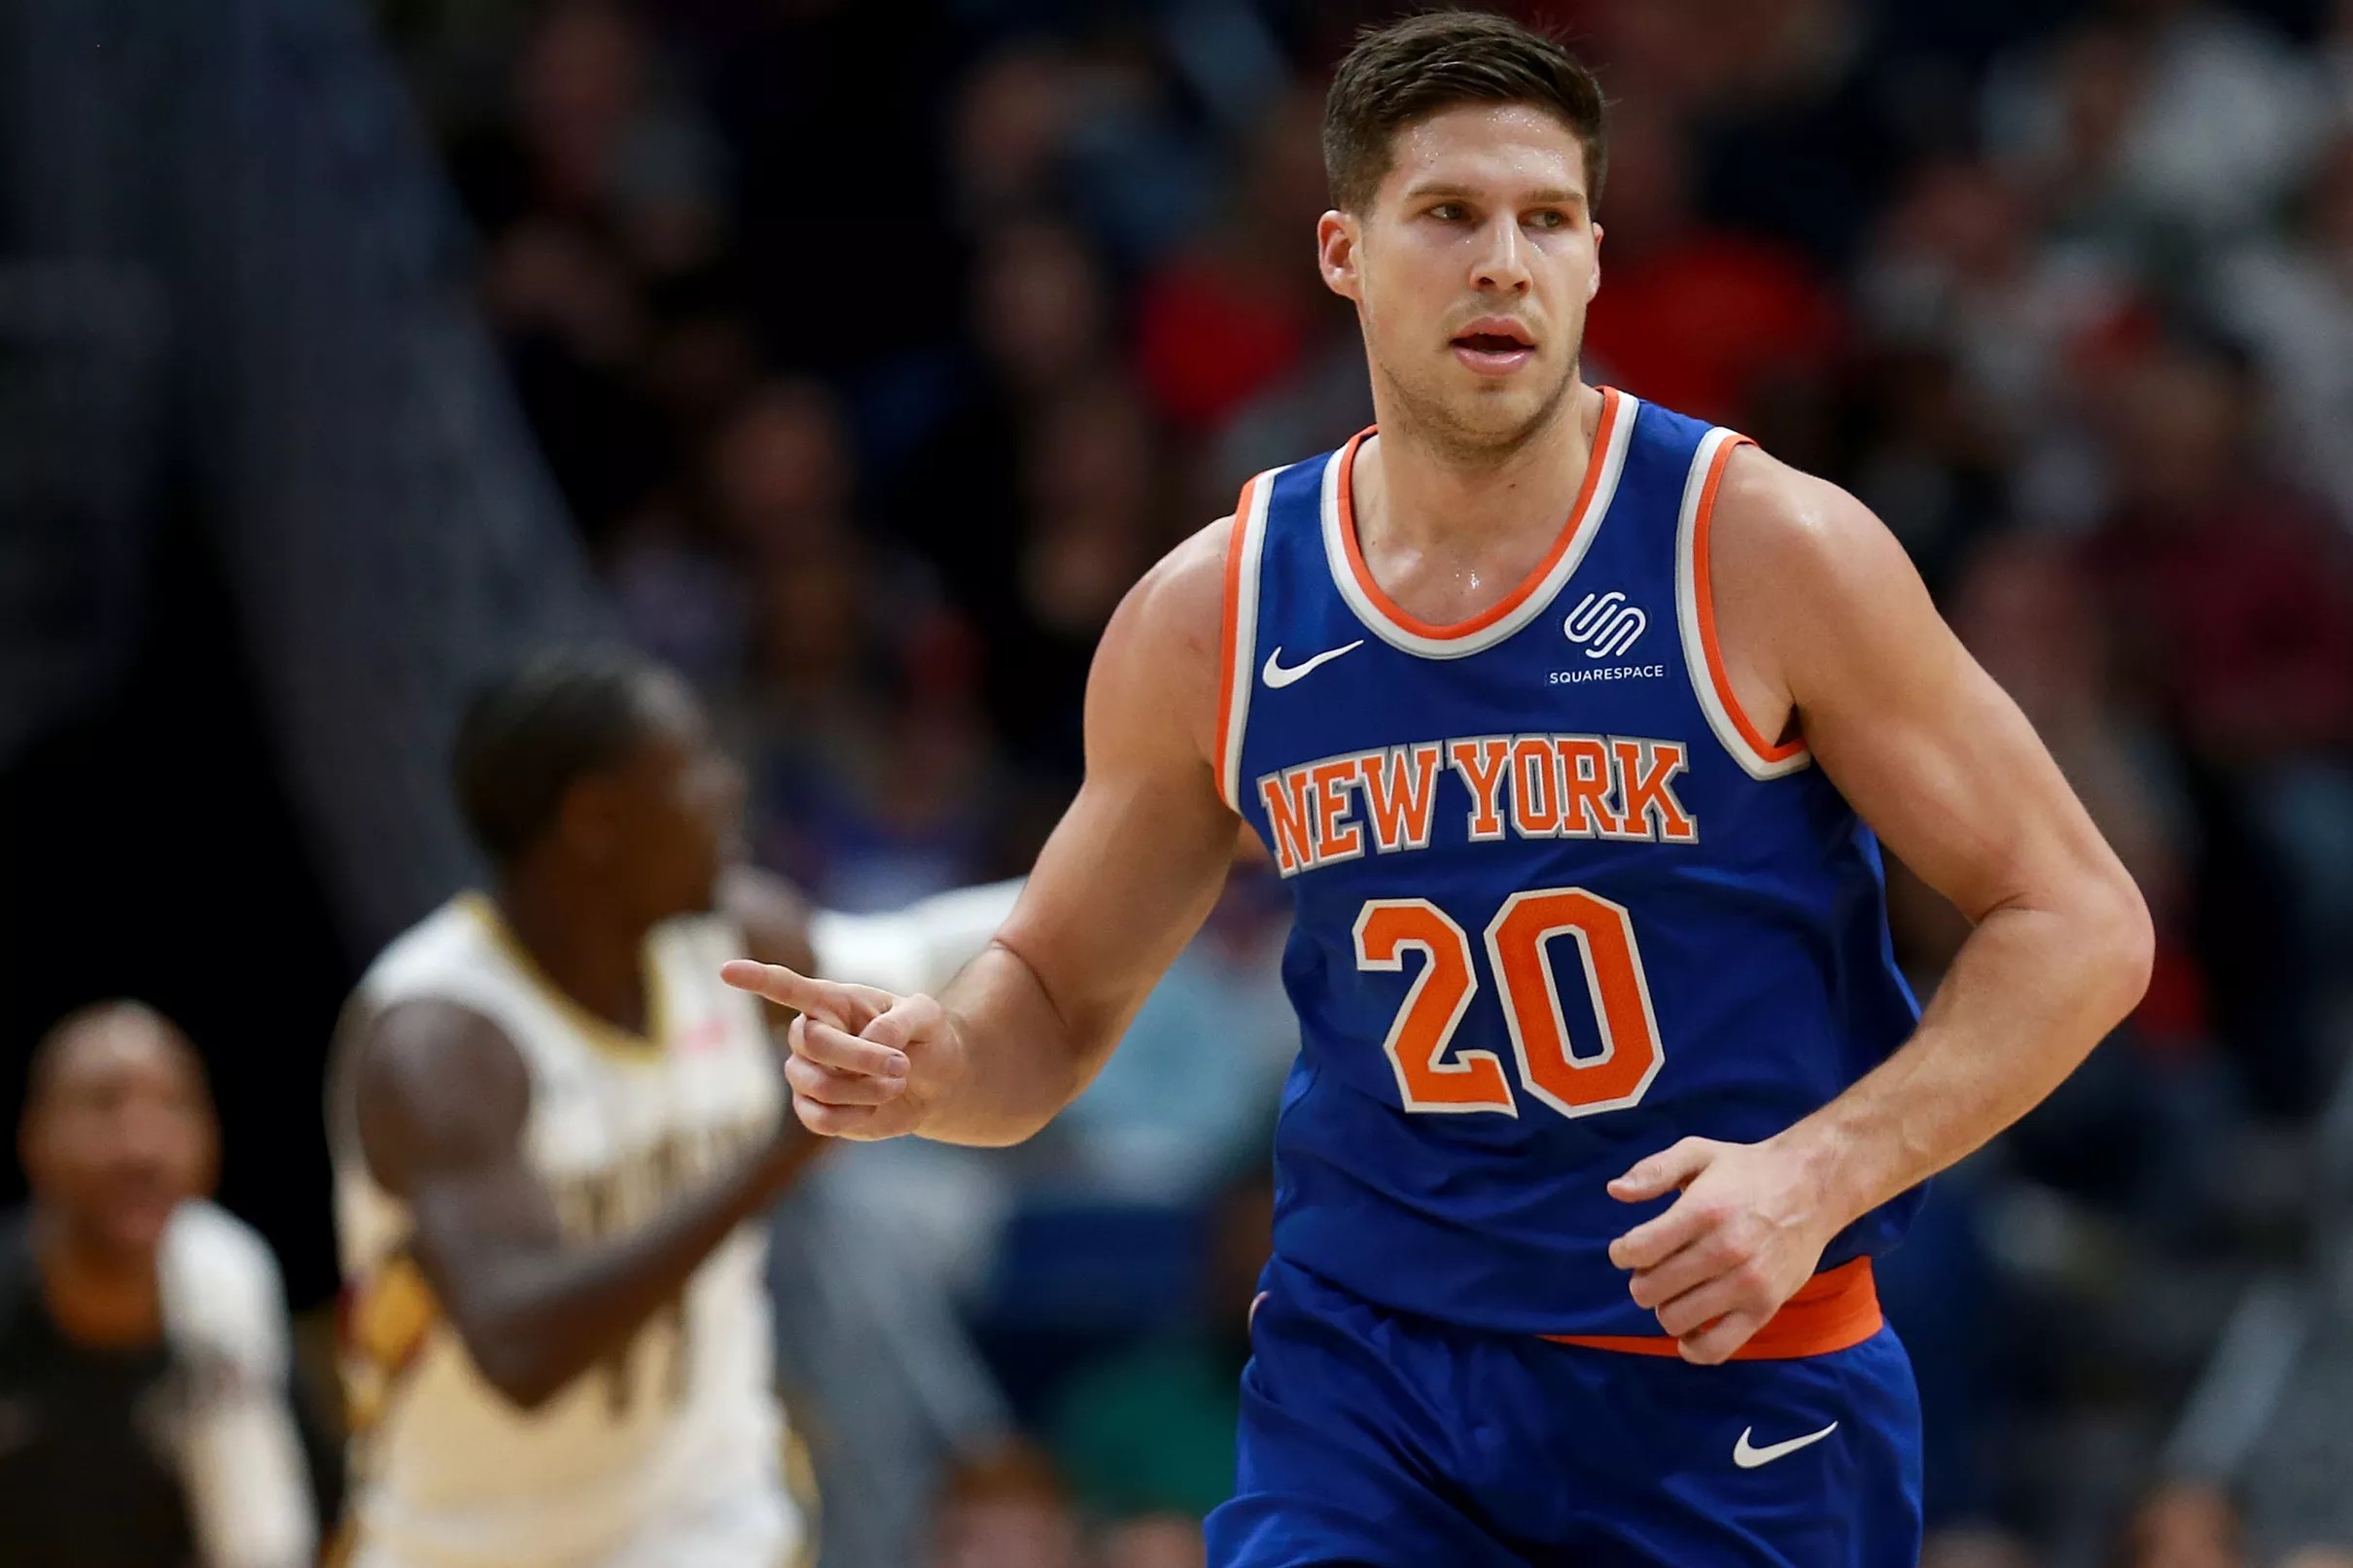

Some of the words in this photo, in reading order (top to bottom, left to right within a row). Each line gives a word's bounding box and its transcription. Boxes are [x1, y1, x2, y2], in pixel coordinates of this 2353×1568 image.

[1549, 665, 1664, 684] SQUARESPACE
[1257, 741, 1443, 878] NEW
[1446, 733, 1700, 844] YORK
[1352, 887, 1665, 1118] 20
